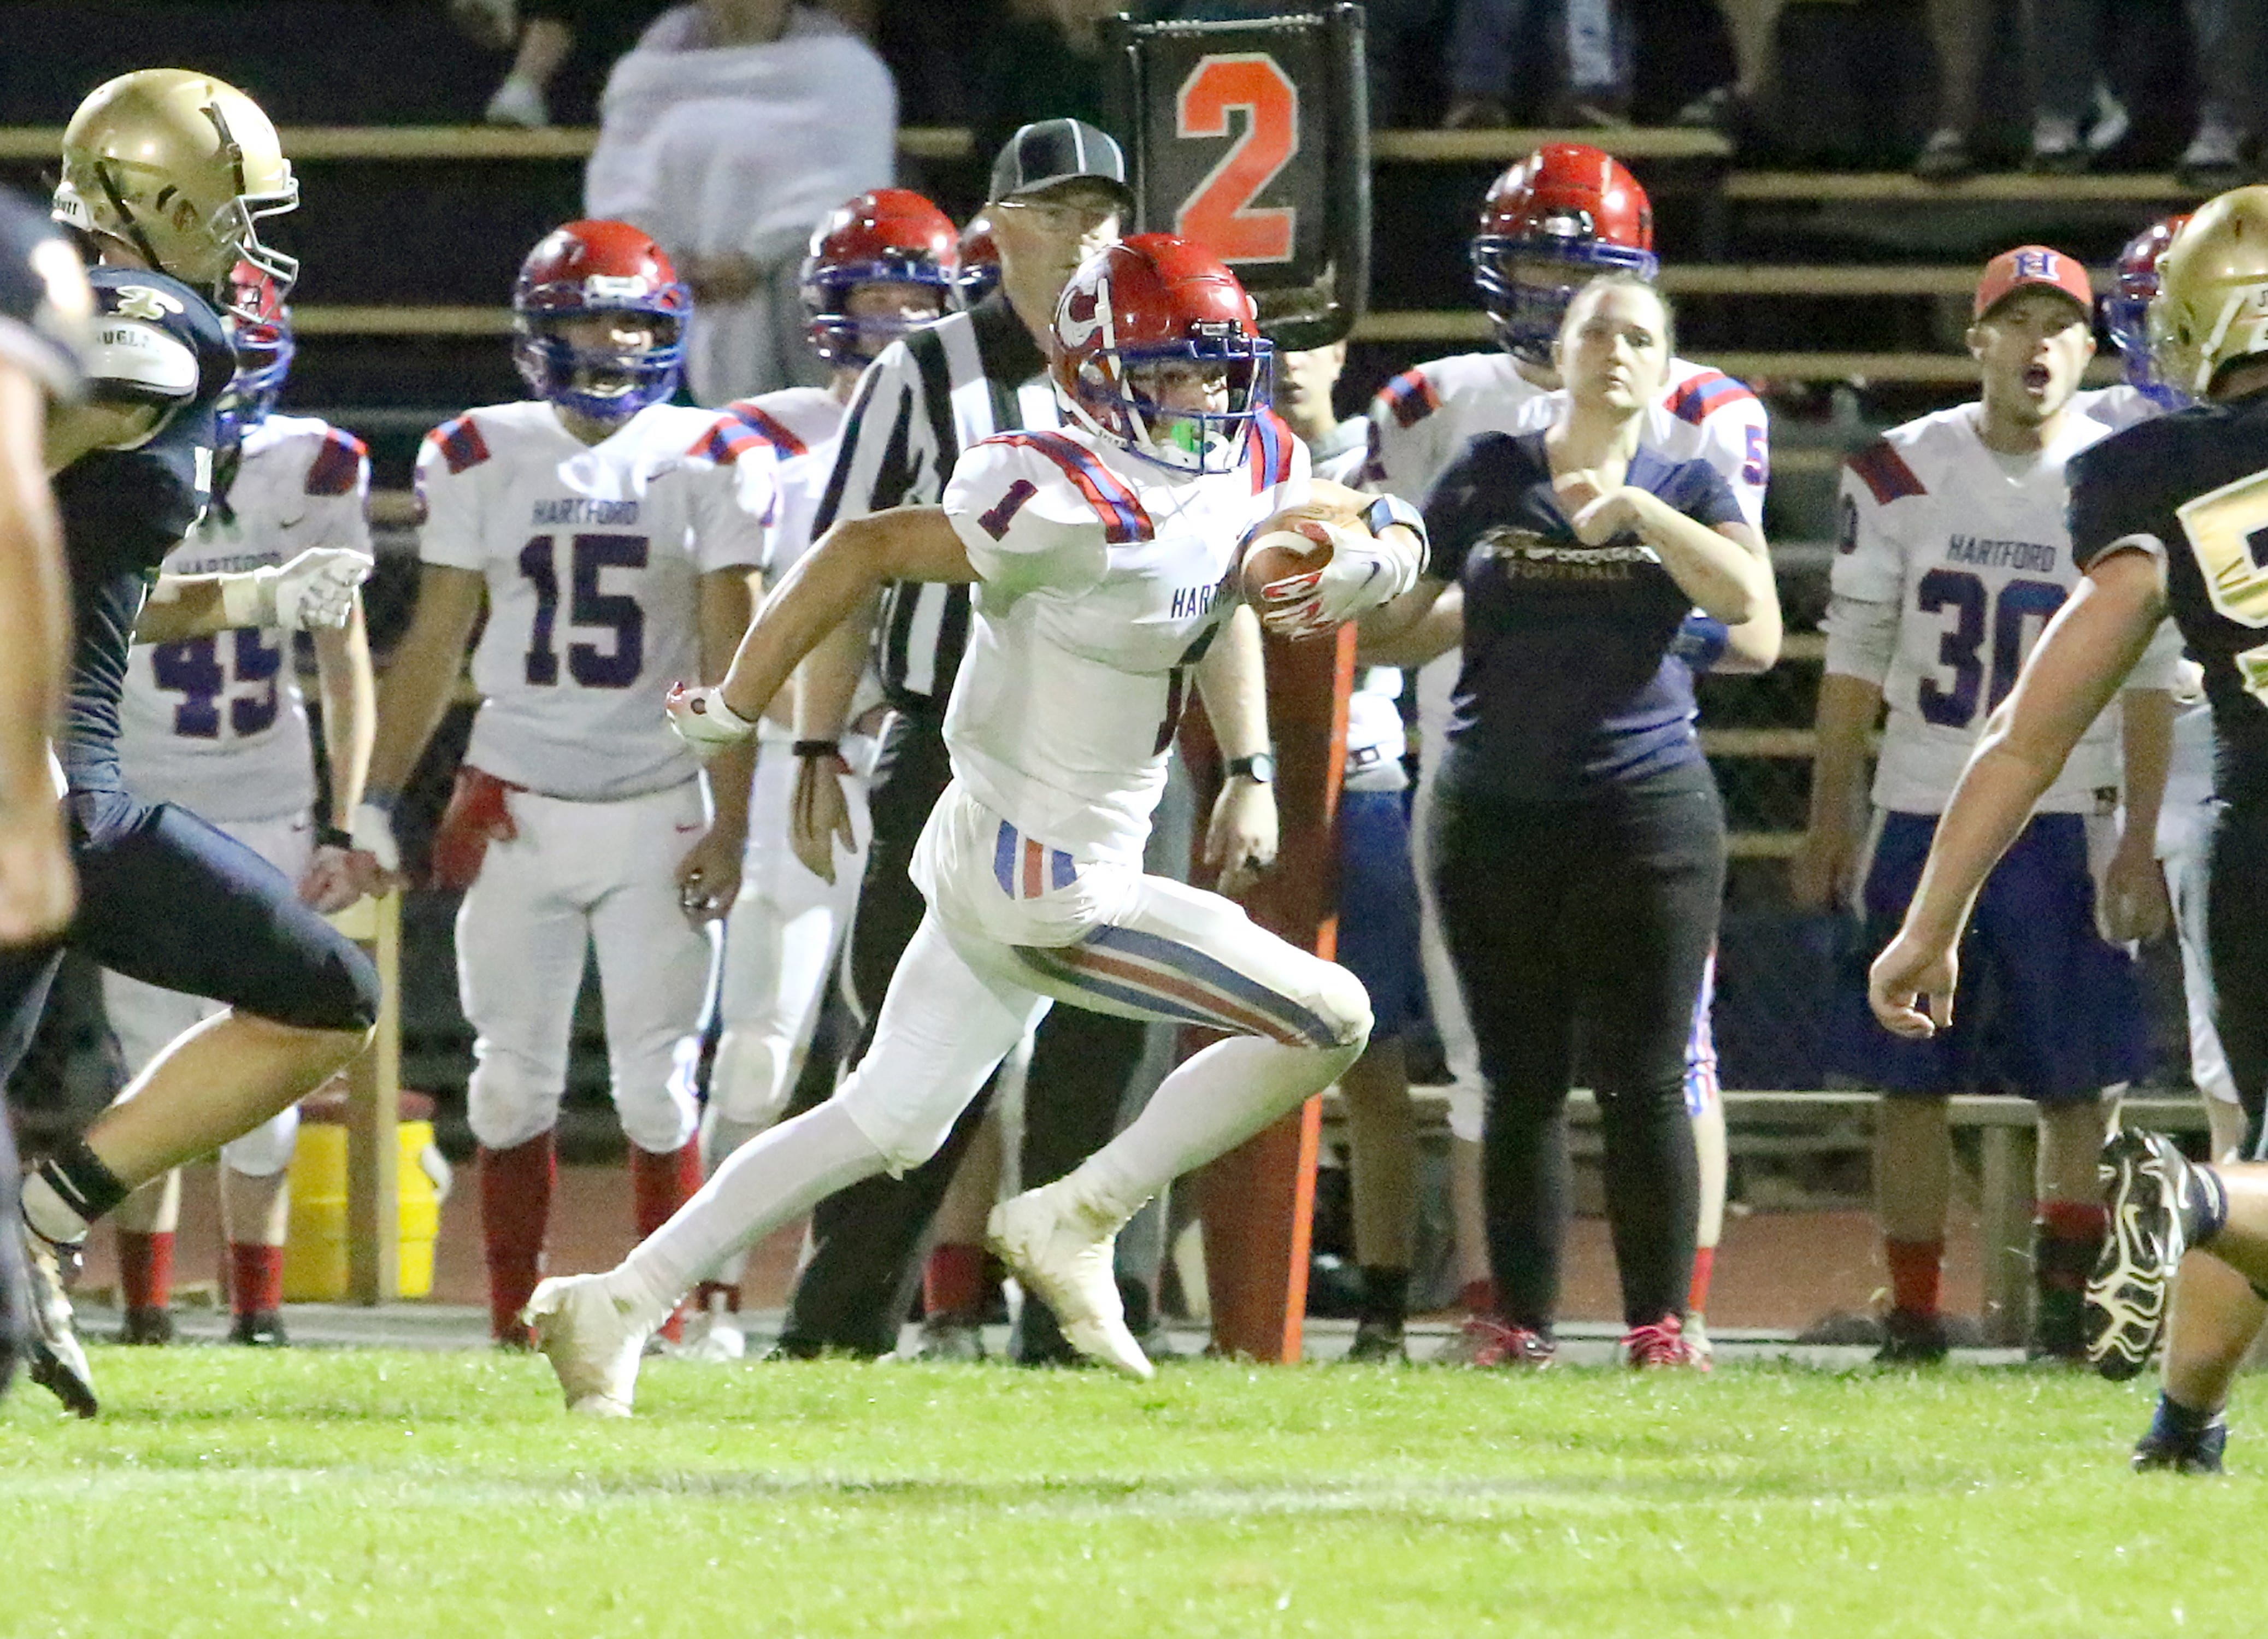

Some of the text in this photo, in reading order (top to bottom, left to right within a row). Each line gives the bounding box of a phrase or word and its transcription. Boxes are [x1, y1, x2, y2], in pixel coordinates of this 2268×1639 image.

[1174, 52, 1299, 264] 2
[2014, 252, 2060, 280] H
[532, 498, 640, 525] HARTFORD
[977, 479, 1038, 541] 1
[1506, 559, 1633, 581] FOOTBALL
[1947, 533, 2057, 573] HARTFORD
[519, 533, 650, 689] 15
[1918, 568, 2069, 728] 30
[151, 627, 280, 738] 45
